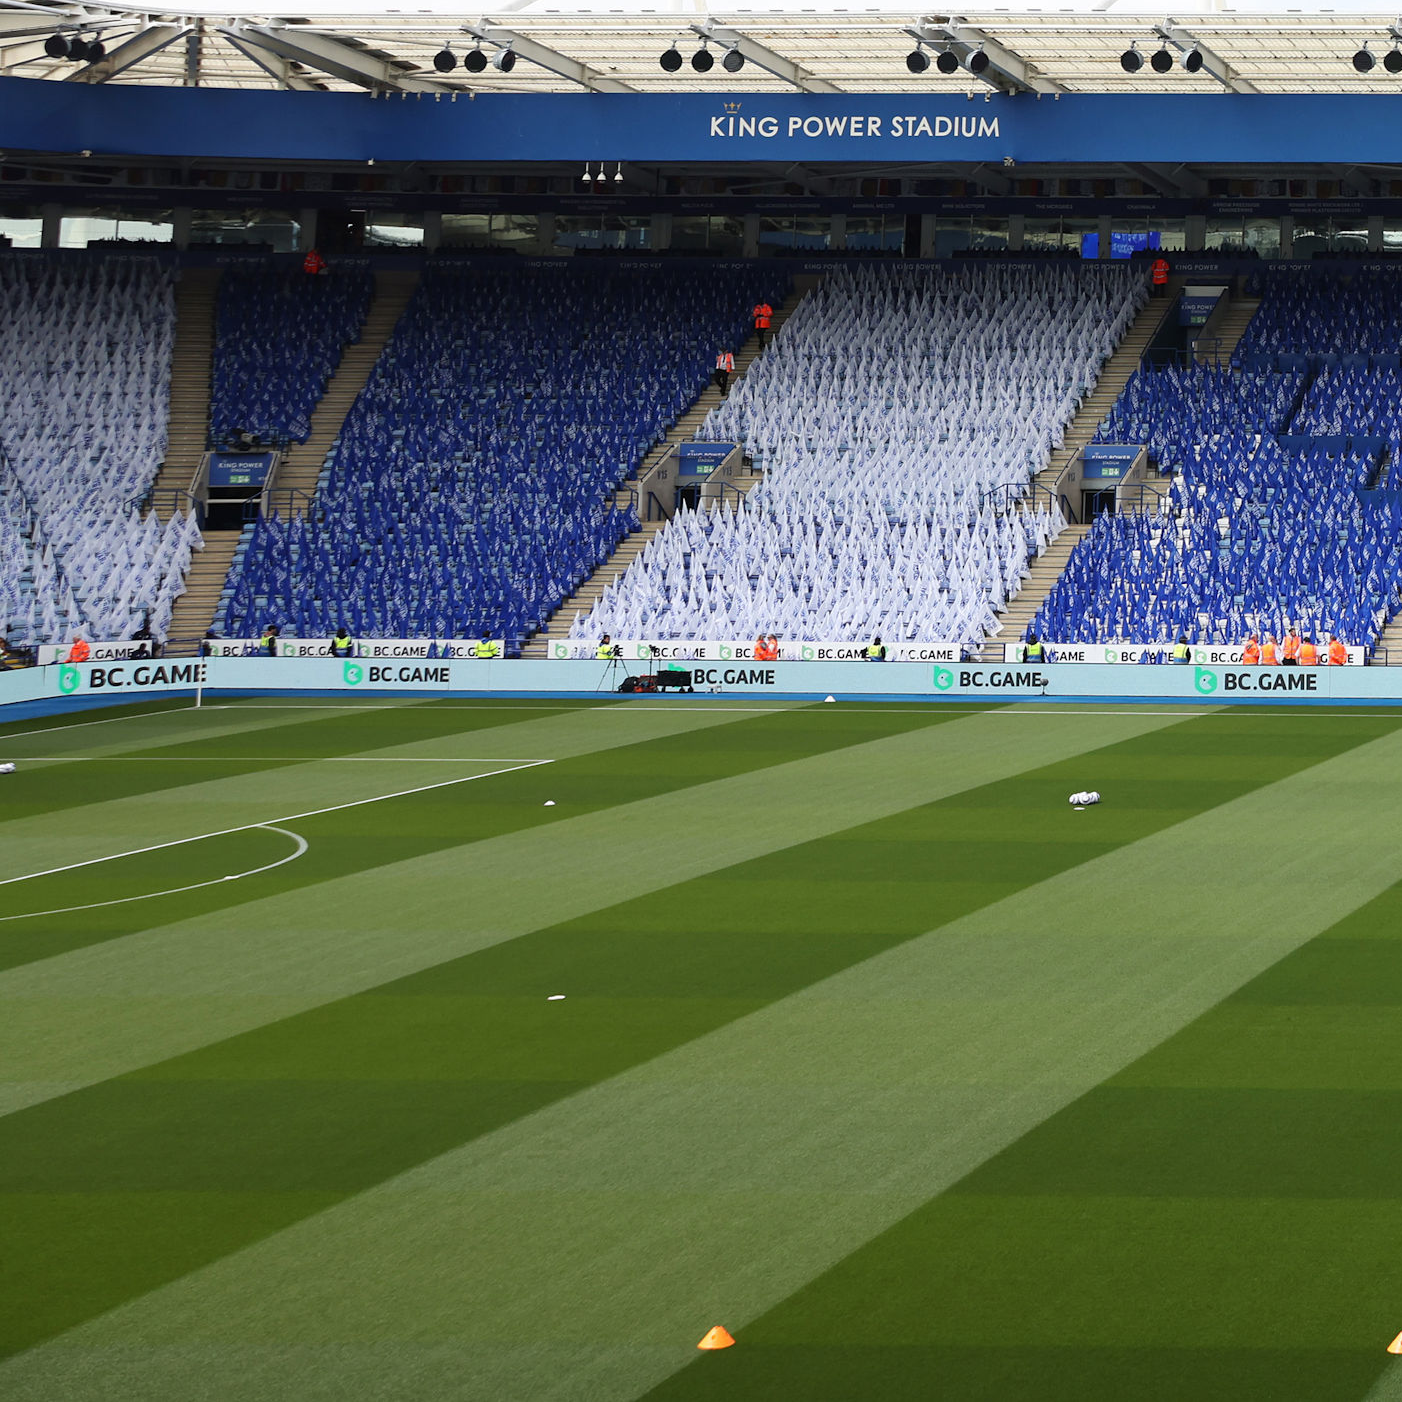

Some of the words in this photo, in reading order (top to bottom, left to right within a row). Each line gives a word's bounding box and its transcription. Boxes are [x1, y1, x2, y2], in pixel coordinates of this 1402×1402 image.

[710, 116, 779, 137] KING
[788, 116, 882, 137] POWER
[890, 116, 1000, 137] STADIUM
[91, 648, 134, 659] .GAME
[299, 646, 334, 657] BC.GA
[374, 646, 427, 657] BC.GAME
[449, 647, 501, 657] BC.GE
[908, 649, 953, 660] C.GAME
[1211, 652, 1244, 663] BC.GA
[90, 663, 207, 689] BC.GAME
[369, 666, 450, 682] BC.GAME
[693, 669, 775, 685] BC.GAME
[959, 671, 1042, 688] BC.GAME
[1224, 673, 1317, 691] BC.GAME
